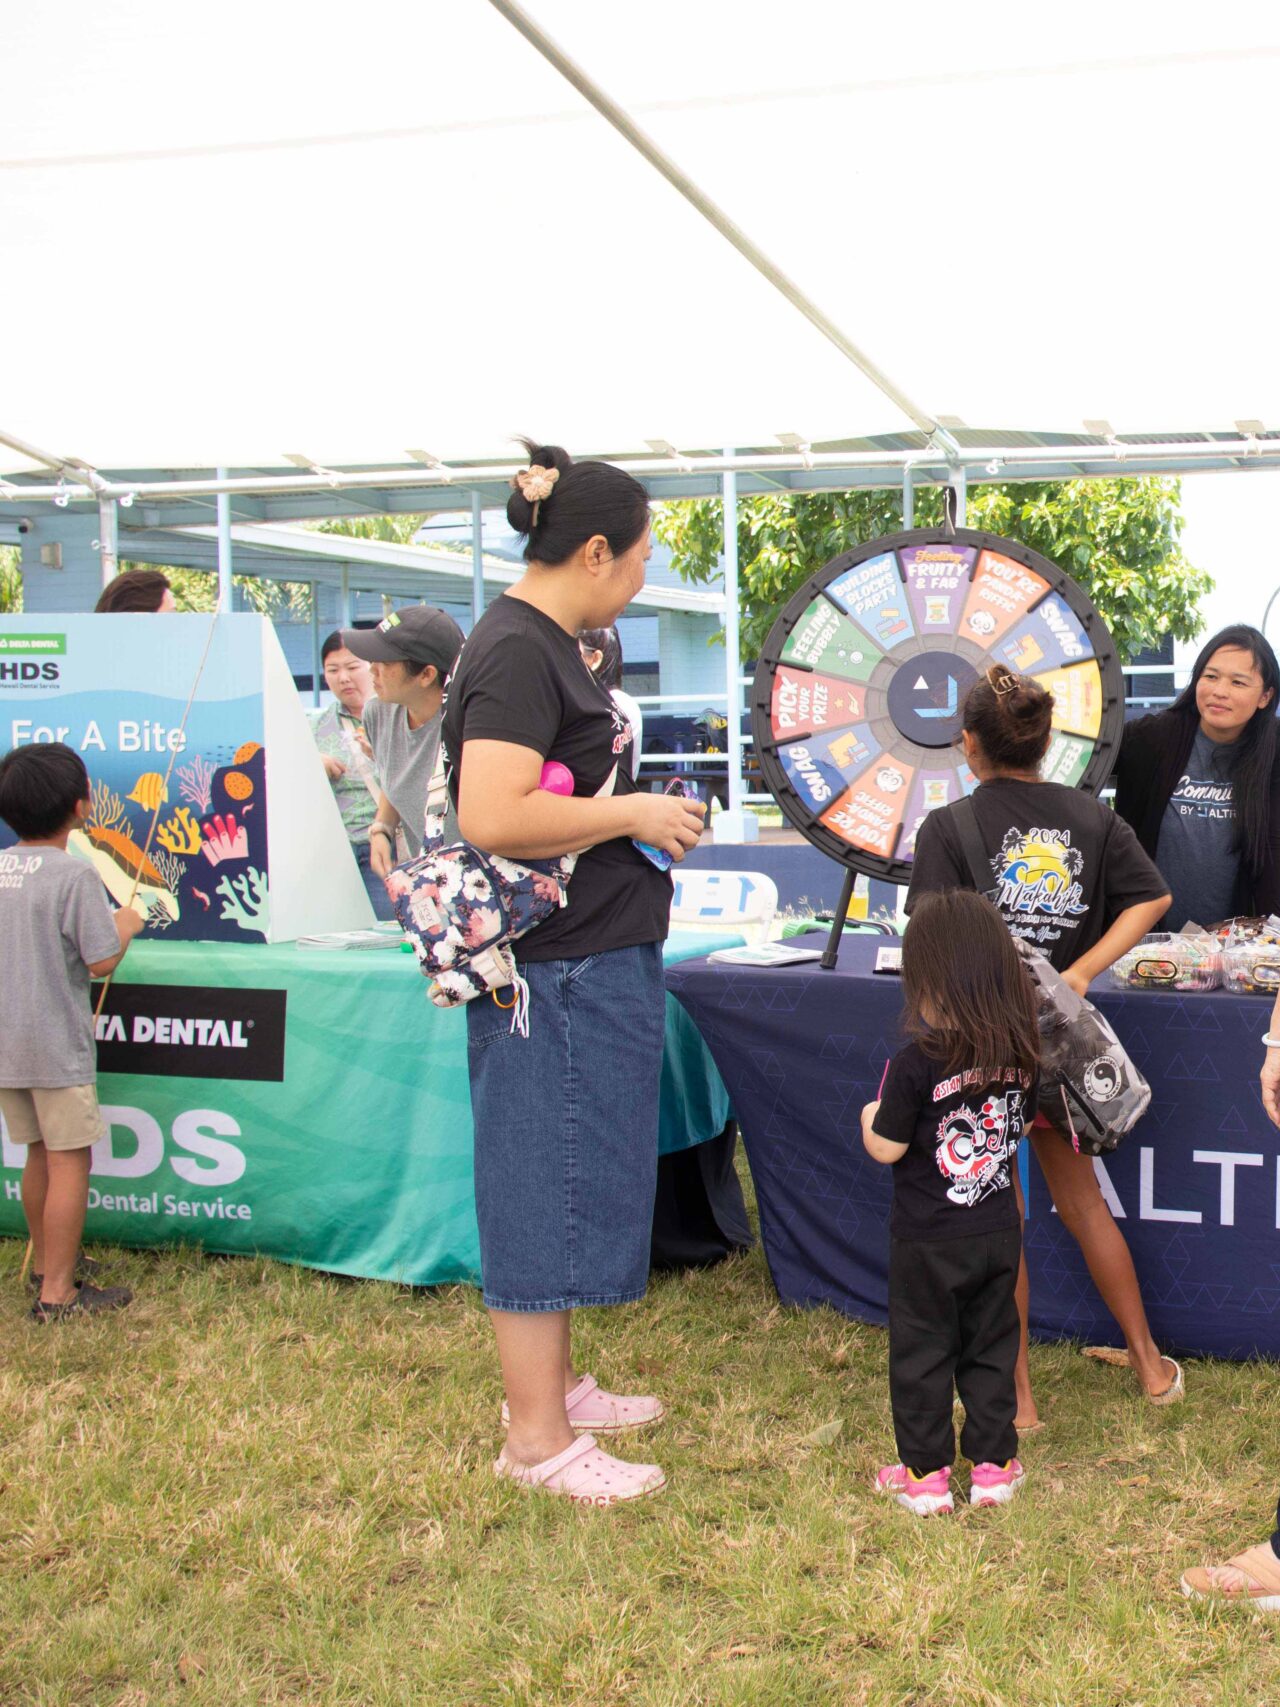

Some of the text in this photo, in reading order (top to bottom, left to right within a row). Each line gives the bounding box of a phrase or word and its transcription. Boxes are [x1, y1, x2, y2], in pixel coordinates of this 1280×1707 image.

[832, 558, 893, 597] BUILDING
[907, 562, 969, 577] FRUITY
[931, 577, 959, 590] FAB
[846, 571, 895, 605] BLOCKS
[854, 583, 898, 615] PARTY
[790, 603, 832, 660] FEELING
[806, 613, 841, 665] BUBBLY
[1040, 602, 1083, 657] SWAG
[0, 662, 60, 681] HDS
[778, 675, 798, 728] PICK
[798, 687, 811, 721] YOUR
[812, 682, 829, 725] PRIZE
[12, 720, 188, 753] For A Bite
[788, 746, 832, 802] SWAG
[1180, 805, 1195, 815] BY
[1029, 827, 1071, 847] 2024
[132, 1015, 248, 1048] DENTAL
[933, 1073, 962, 1102] ASIAN
[88, 1189, 252, 1220] Dental Service
